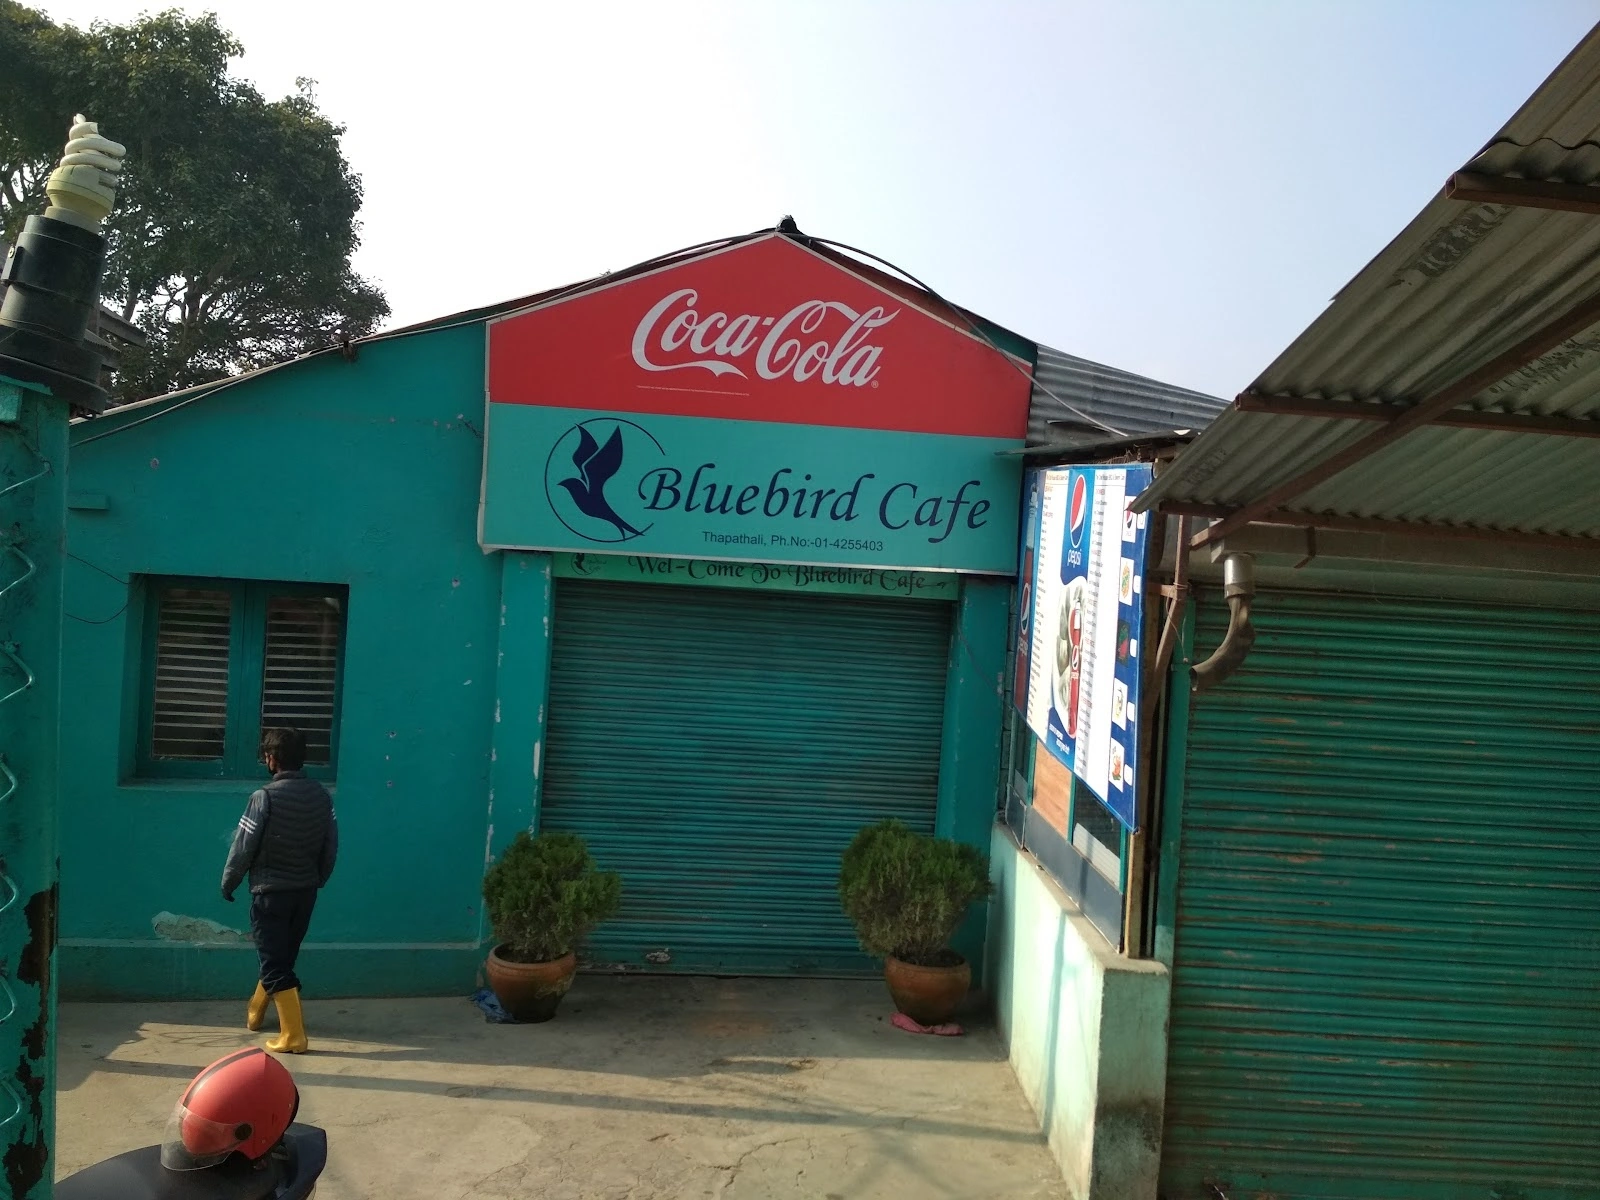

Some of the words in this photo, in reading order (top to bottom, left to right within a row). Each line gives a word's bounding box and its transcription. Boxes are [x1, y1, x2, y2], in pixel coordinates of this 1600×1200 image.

[631, 288, 902, 388] Coca-Cola
[637, 462, 875, 522] Bluebird
[878, 479, 991, 545] Cafe
[702, 531, 767, 547] Thapathali,
[770, 535, 884, 552] Ph.No:-01-4255403
[1066, 548, 1082, 569] pepsi
[787, 564, 873, 586] Bluebird
[879, 568, 926, 595] Cafe
